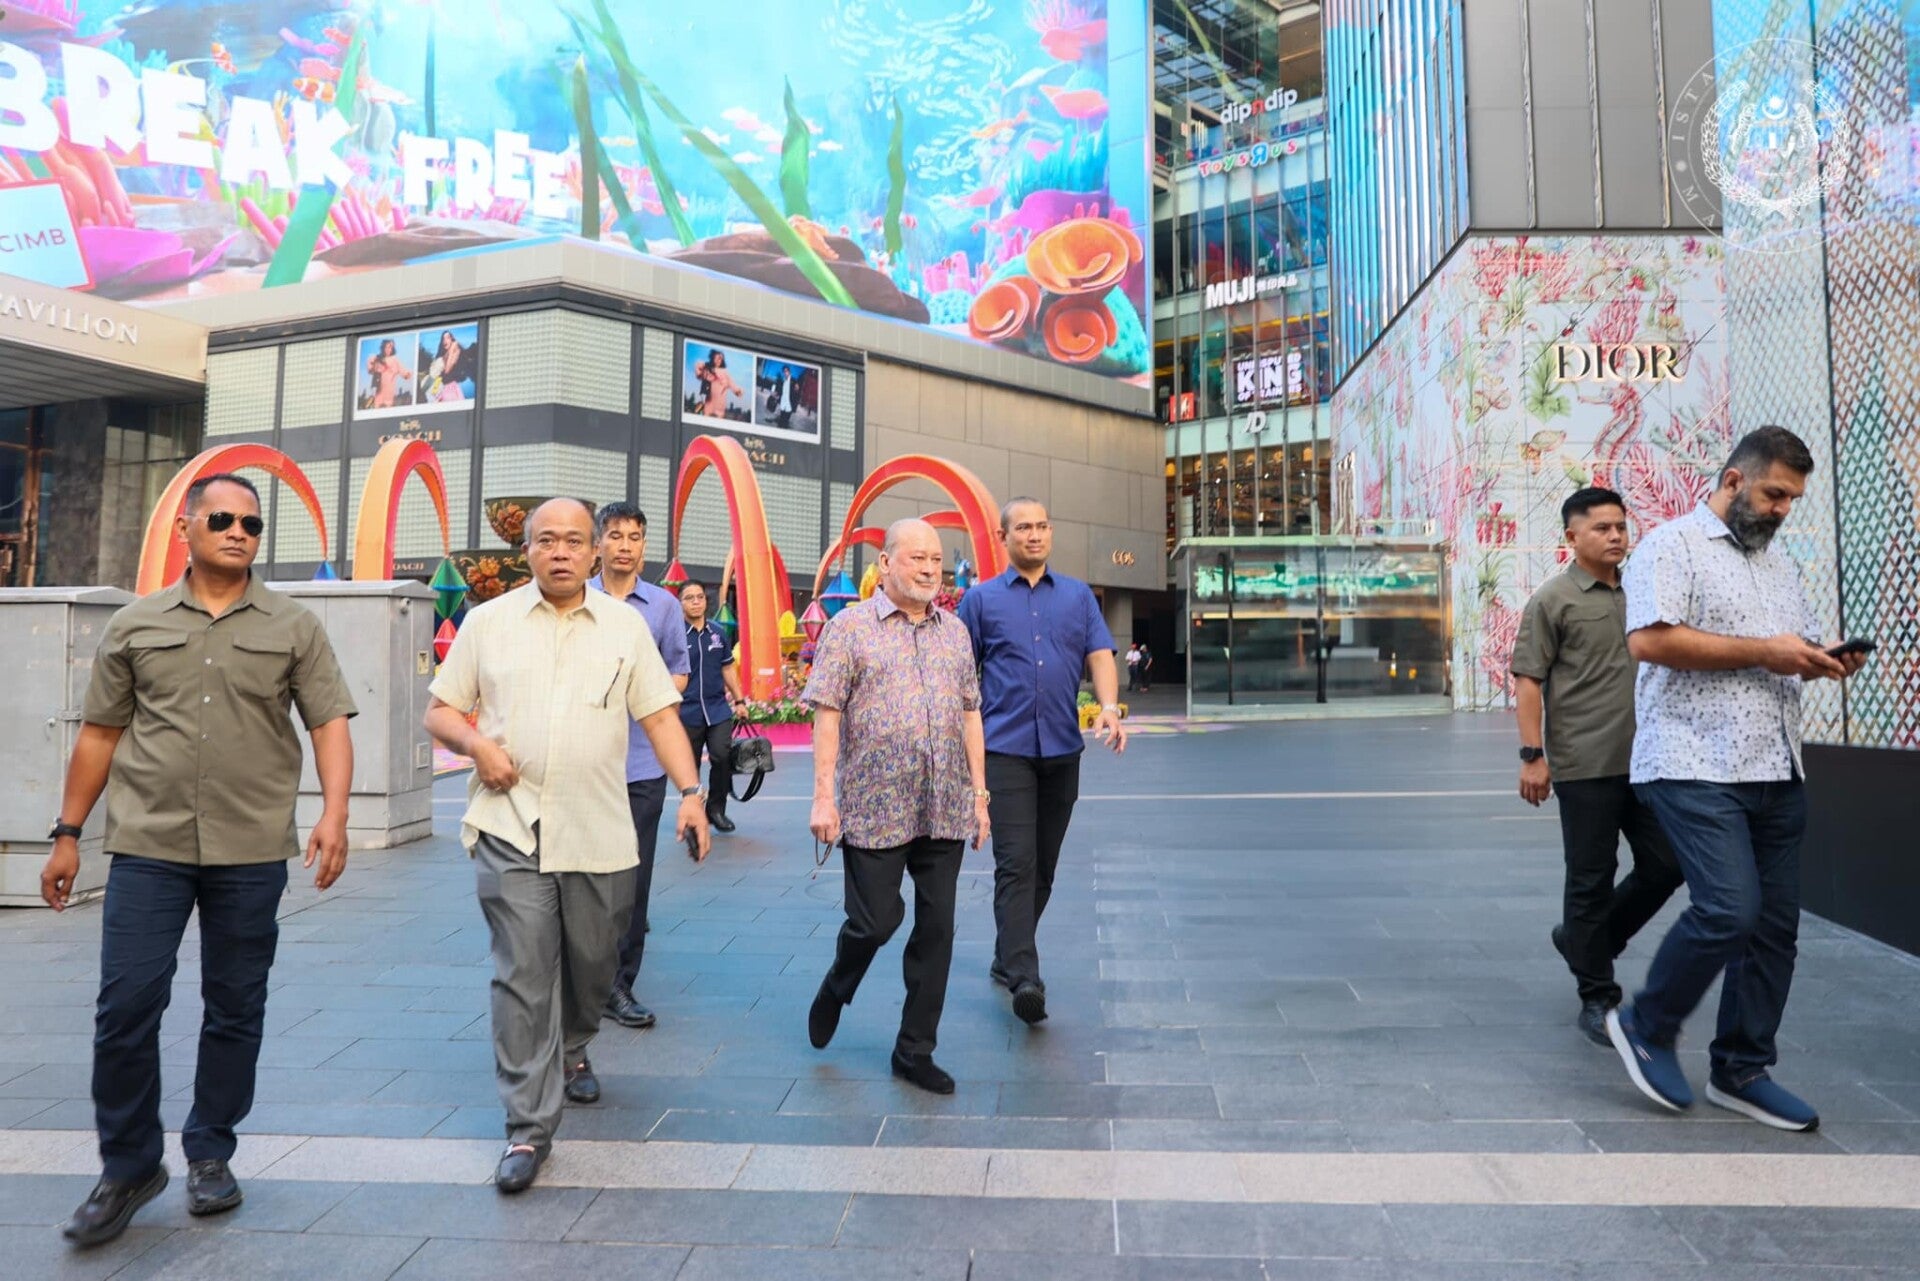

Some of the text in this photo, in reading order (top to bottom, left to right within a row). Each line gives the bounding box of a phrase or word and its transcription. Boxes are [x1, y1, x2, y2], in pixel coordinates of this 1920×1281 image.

[1220, 87, 1298, 124] dipndip
[0, 41, 569, 218] BREAK FREE
[0, 228, 67, 253] CIMB
[1205, 275, 1256, 309] MUJI
[0, 291, 139, 346] AVILION
[1237, 363, 1302, 392] KING
[1552, 343, 1686, 384] DIOR
[1243, 411, 1266, 433] JD
[750, 450, 785, 465] ACH
[392, 562, 424, 571] OACH
